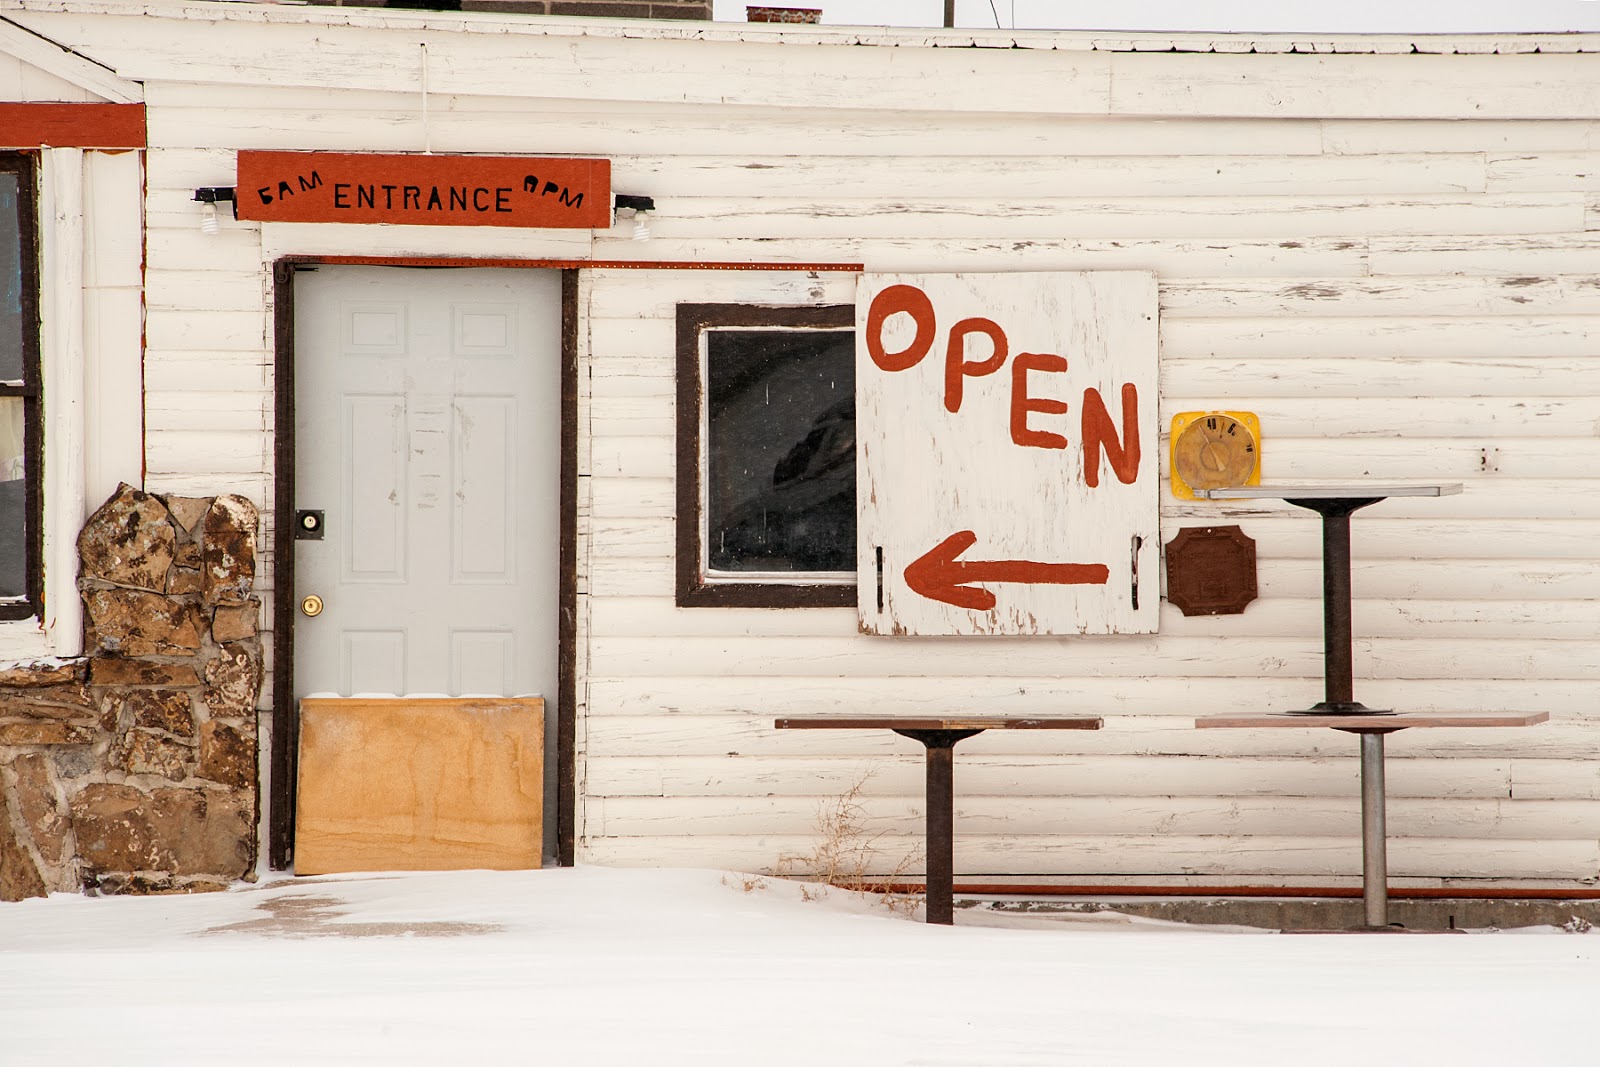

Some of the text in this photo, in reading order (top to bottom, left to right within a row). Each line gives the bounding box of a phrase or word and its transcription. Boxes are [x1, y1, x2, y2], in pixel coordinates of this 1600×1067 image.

[257, 170, 323, 205] 5AM
[334, 183, 513, 213] ENTRANCE
[865, 284, 1141, 488] OPEN
